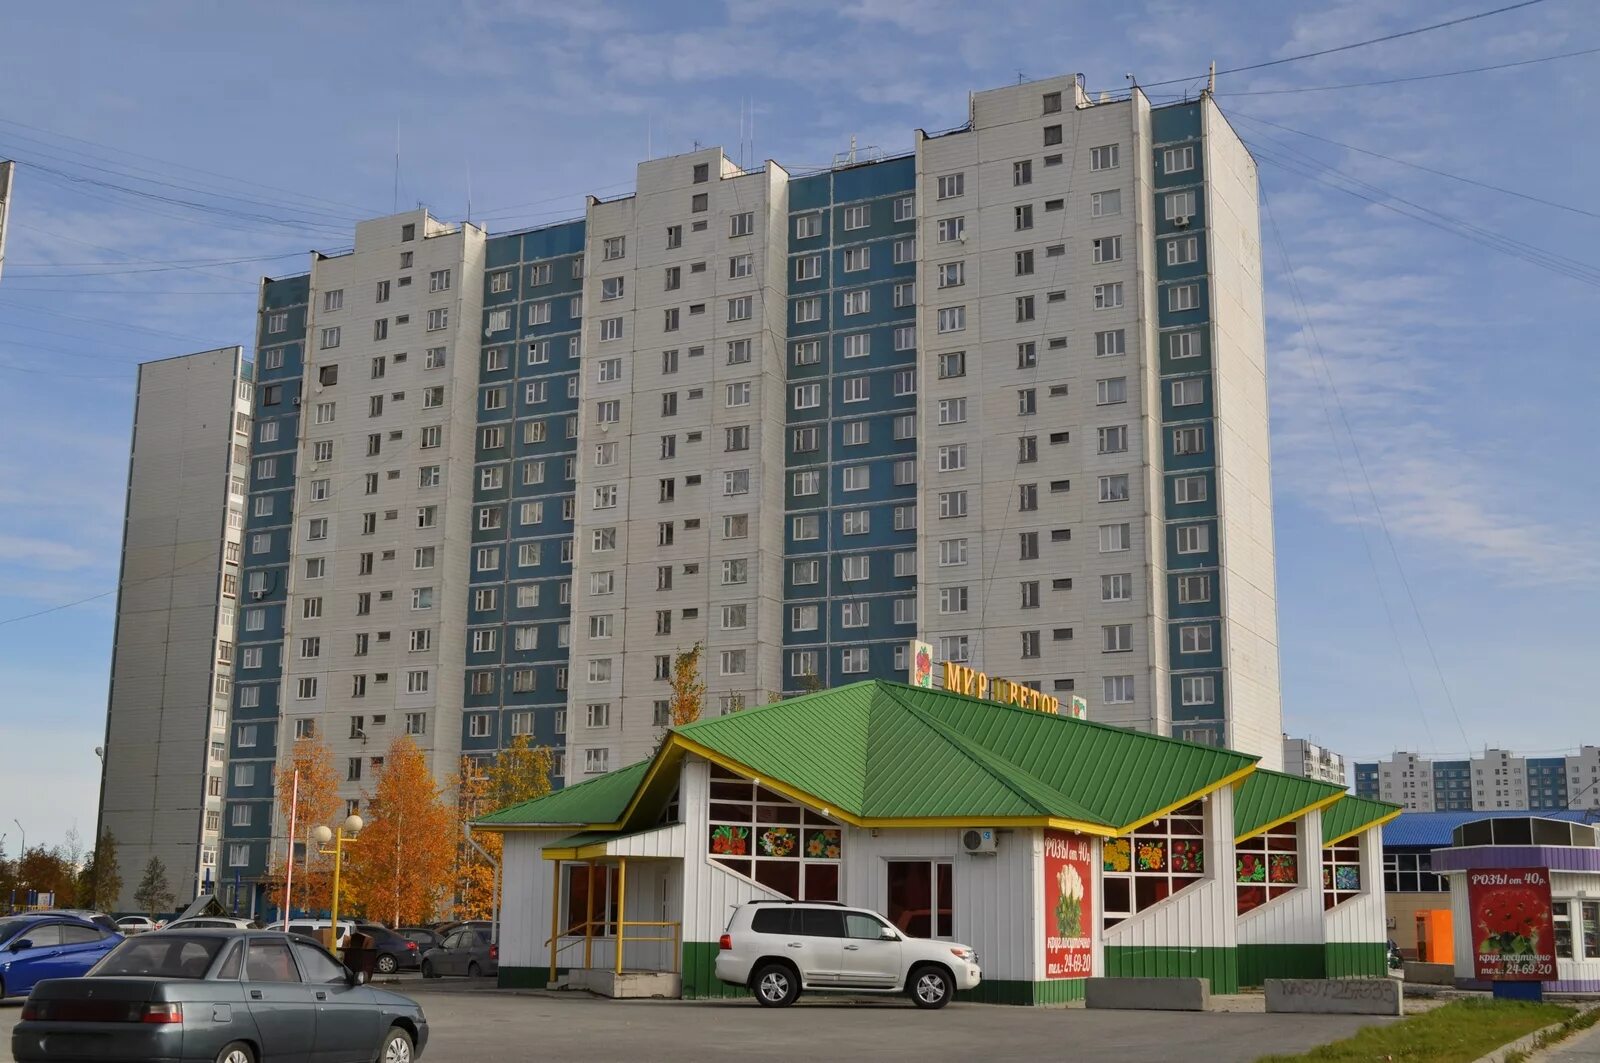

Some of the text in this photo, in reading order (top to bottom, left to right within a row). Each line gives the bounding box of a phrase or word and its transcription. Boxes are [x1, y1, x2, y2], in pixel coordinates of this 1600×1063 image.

[944, 661, 988, 699] МИР
[1045, 837, 1069, 860] РОЗЫ
[1472, 874, 1508, 885] РОЗЫ
[1524, 872, 1546, 886] 40р.
[1064, 953, 1091, 972] 24-69-20
[1479, 954, 1551, 964] круглосуточно
[1506, 963, 1552, 975] 24-69-20
